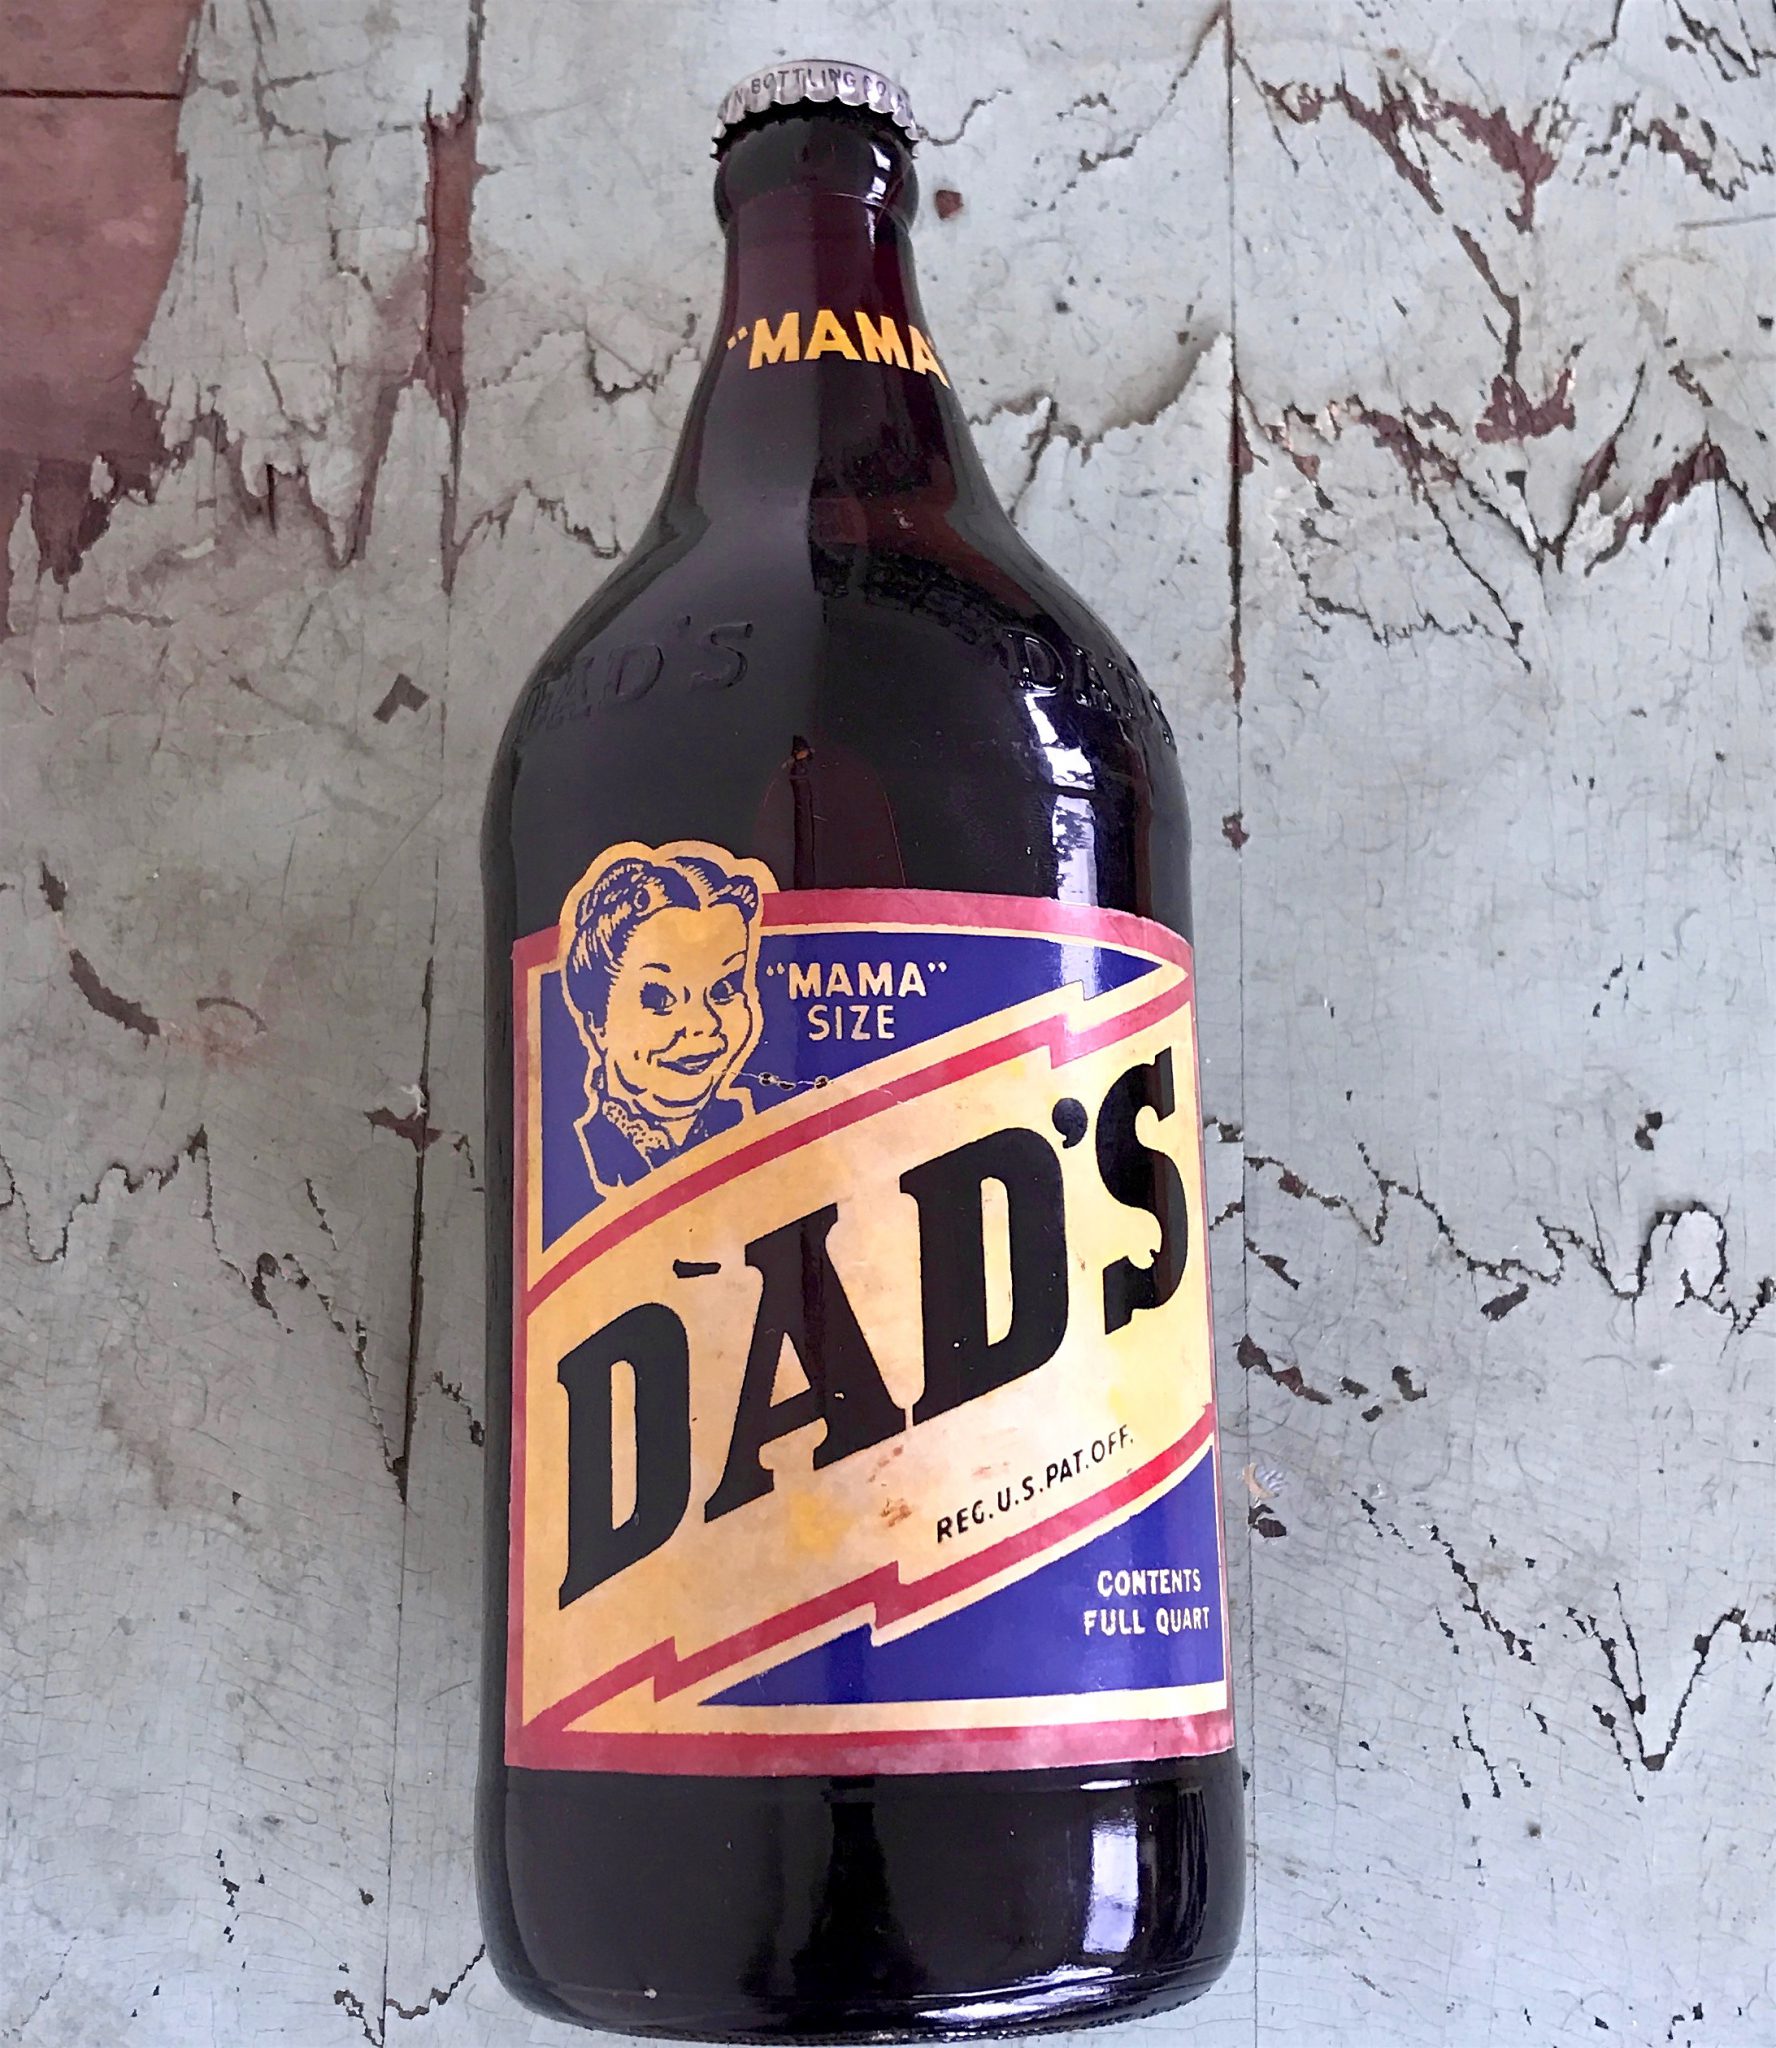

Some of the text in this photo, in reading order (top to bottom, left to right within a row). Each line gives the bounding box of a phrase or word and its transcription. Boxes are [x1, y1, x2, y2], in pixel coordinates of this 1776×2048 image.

[751, 67, 857, 95] BOTTLING
[766, 961, 947, 1000] “MAMA”
[807, 1004, 896, 1041] SIZE
[557, 1046, 1188, 1610] DAD'S
[1096, 1568, 1202, 1597] CONTENTS
[1083, 1607, 1210, 1636] FULL QUART
